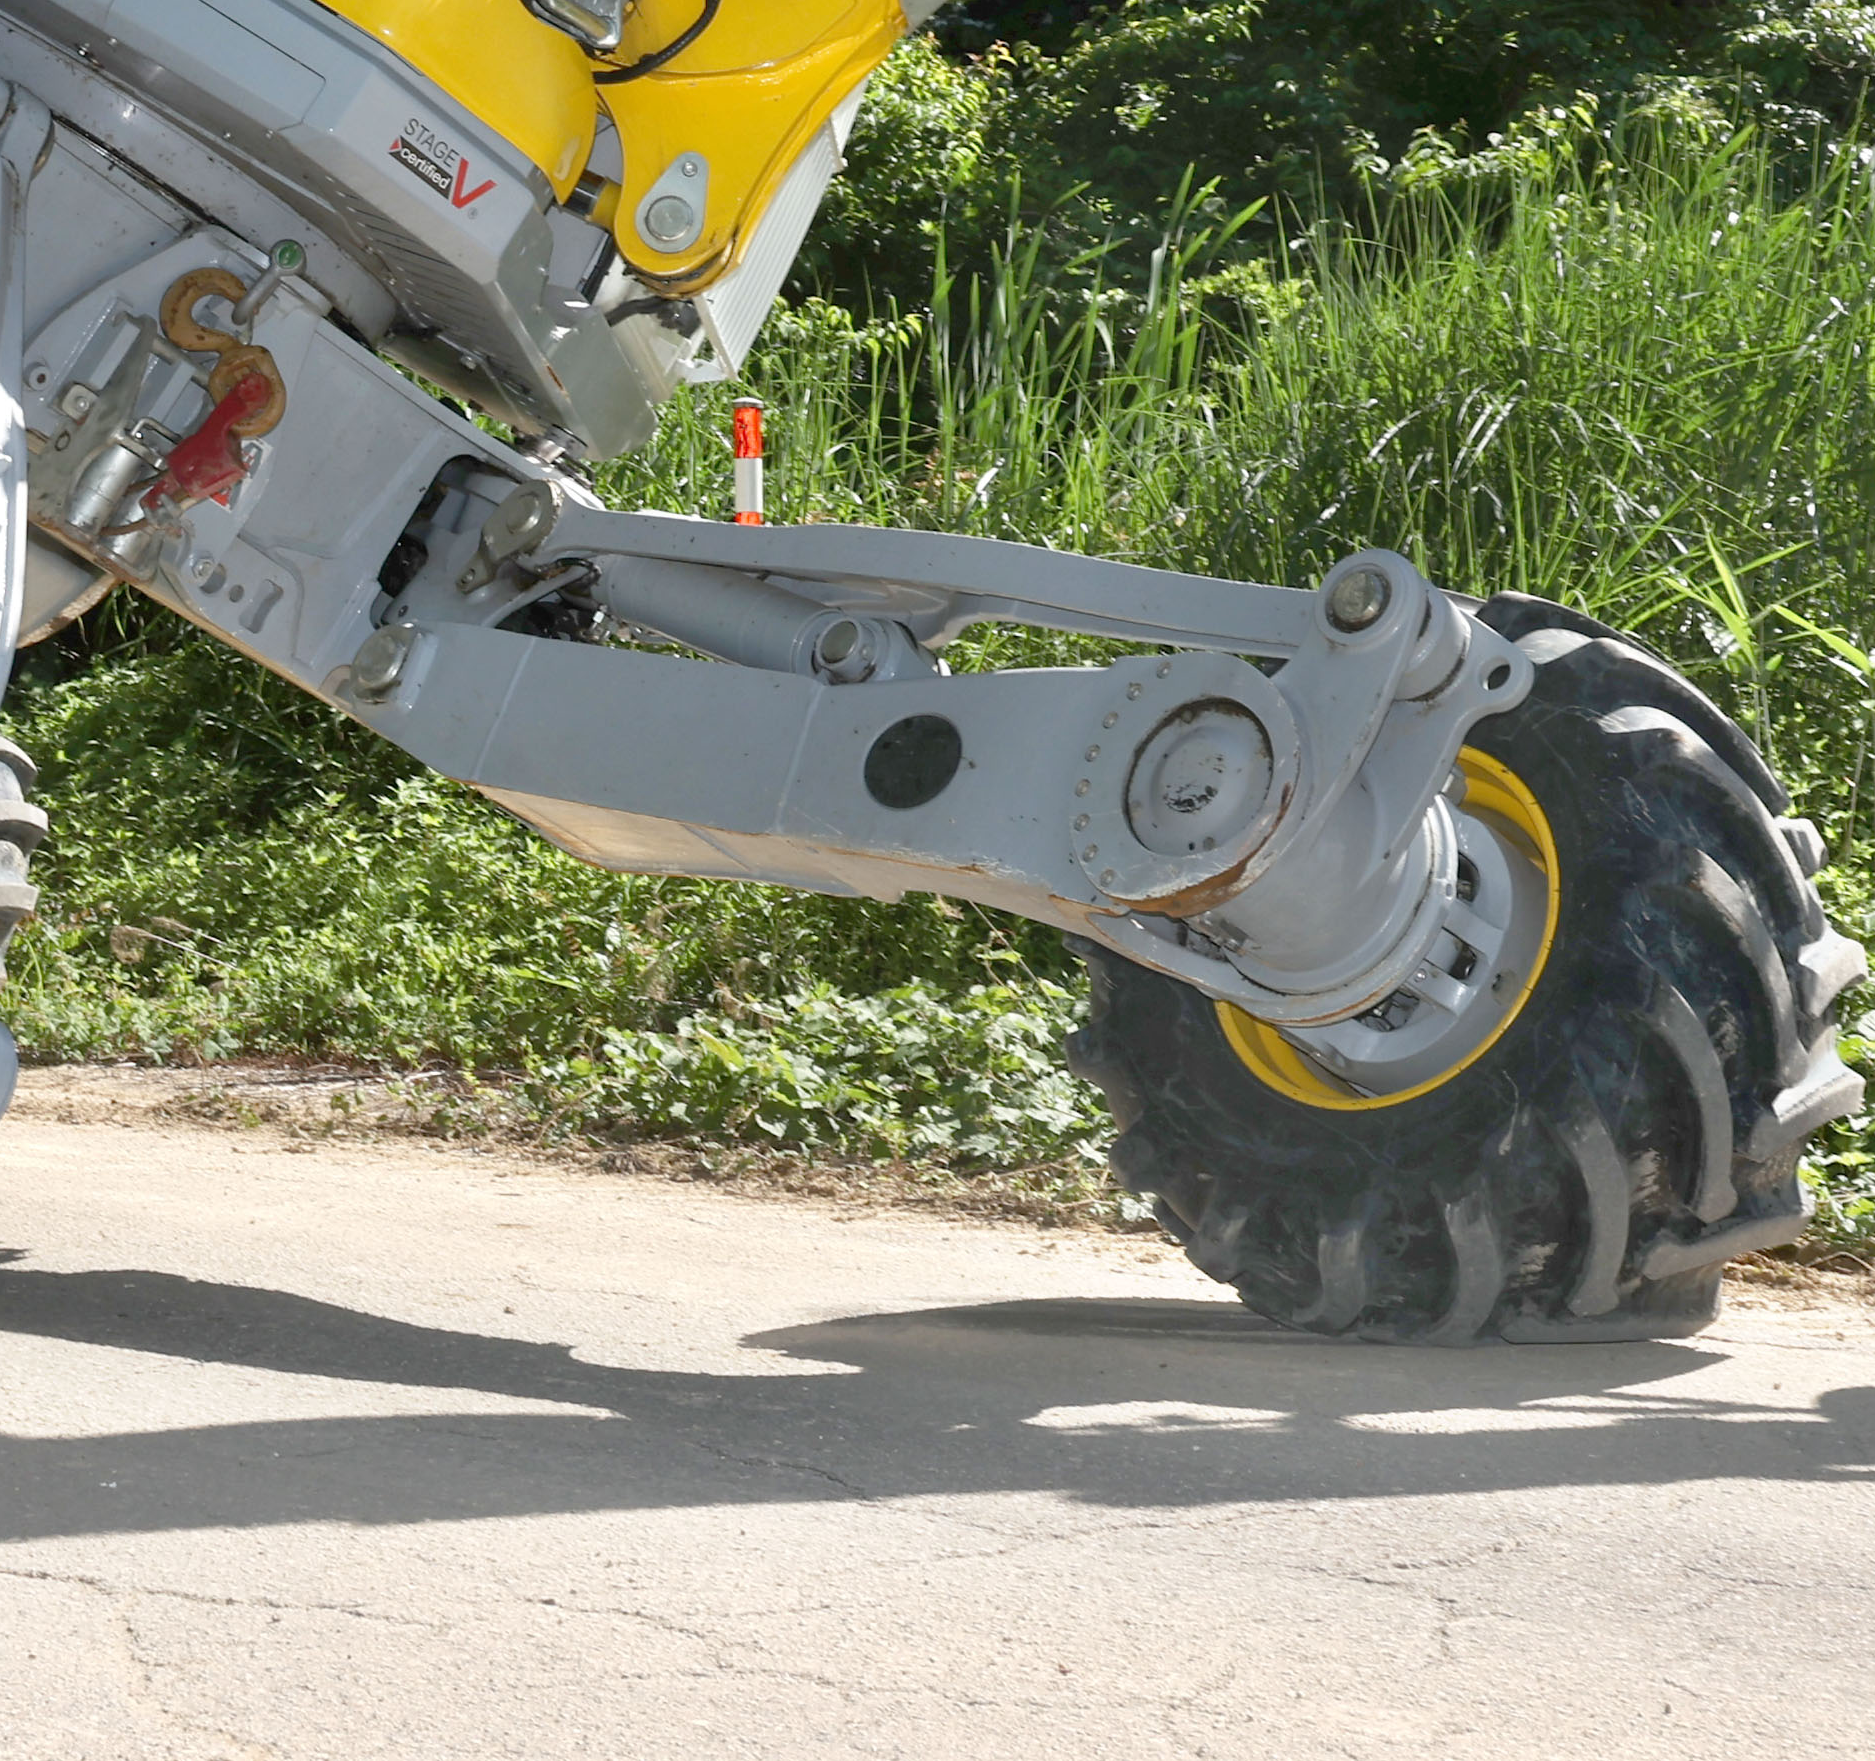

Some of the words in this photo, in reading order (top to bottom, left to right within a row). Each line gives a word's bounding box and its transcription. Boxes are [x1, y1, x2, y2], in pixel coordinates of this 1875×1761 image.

[400, 147, 452, 190] certified
[403, 117, 460, 169] STAGE
[451, 156, 498, 209] V
